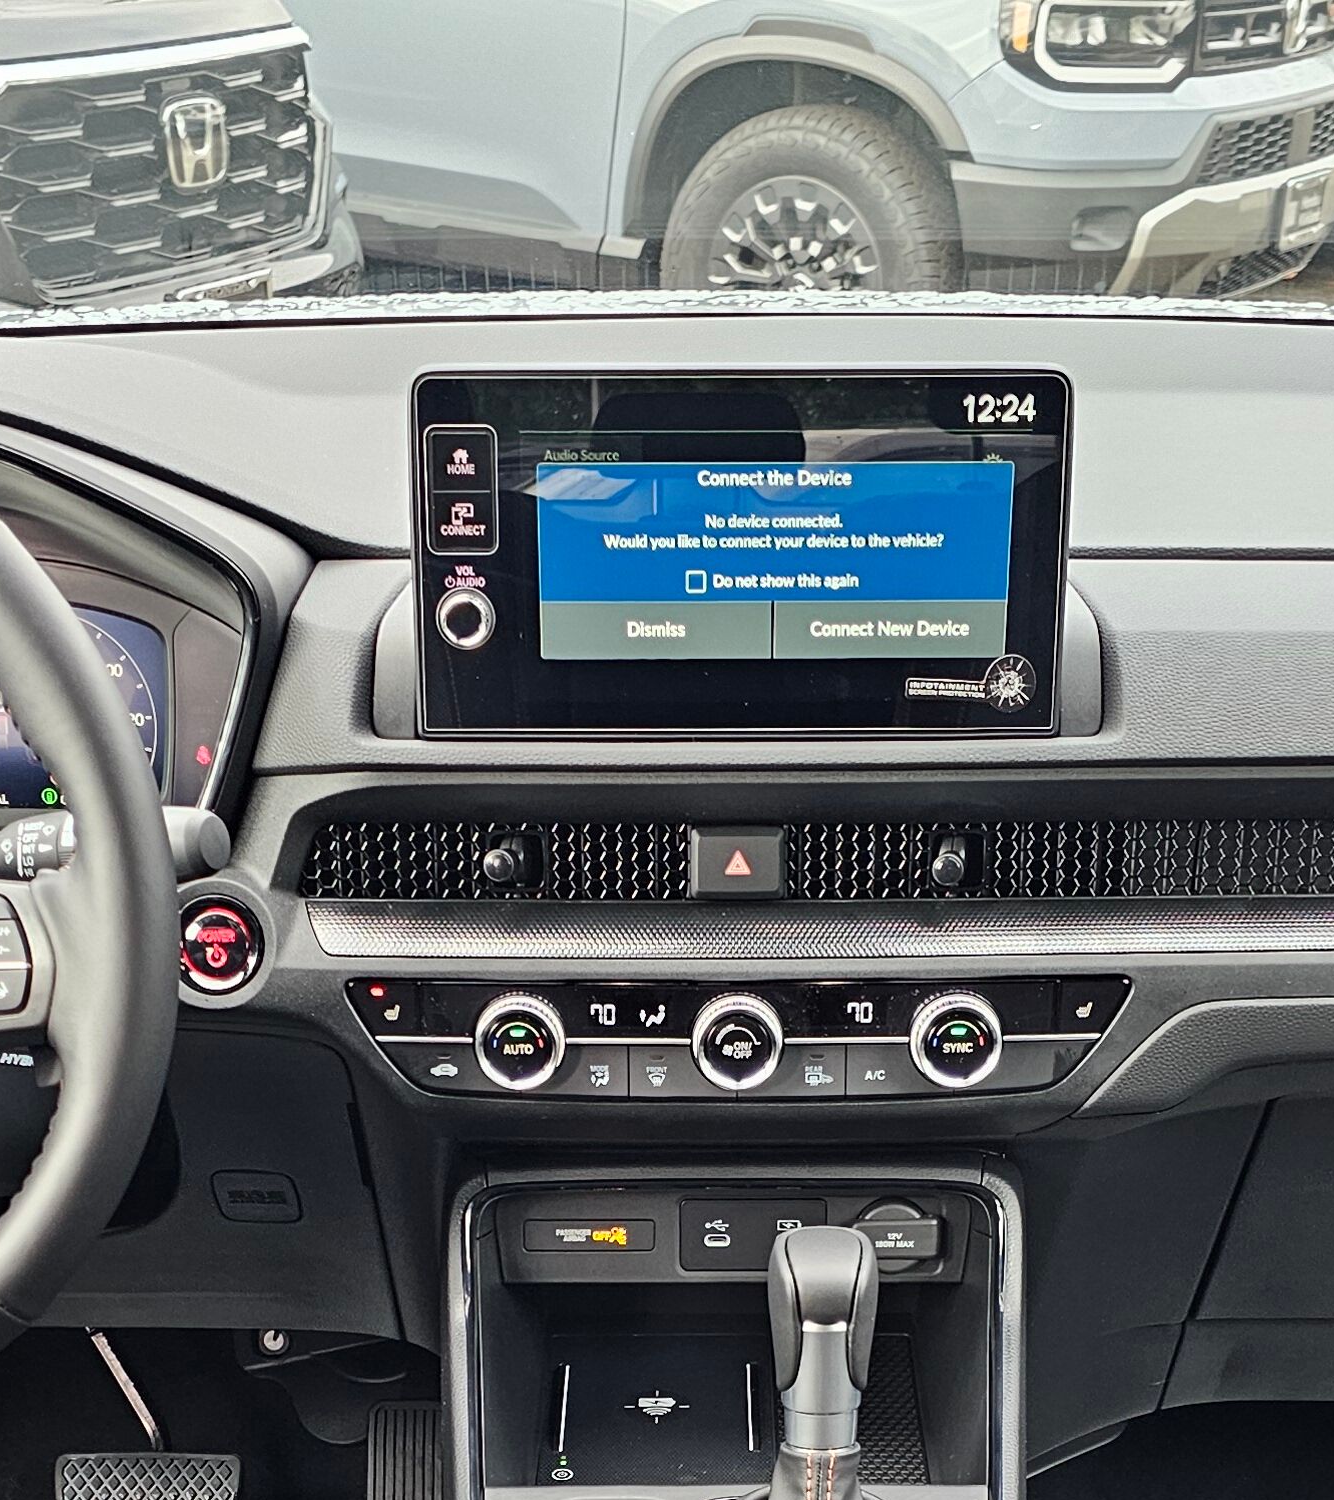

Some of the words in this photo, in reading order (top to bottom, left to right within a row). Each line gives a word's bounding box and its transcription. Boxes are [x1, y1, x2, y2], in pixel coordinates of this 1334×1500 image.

[963, 393, 1037, 423] 12:24
[544, 450, 578, 462] Audio
[580, 450, 620, 462] Source
[447, 464, 475, 475] HOME
[697, 470, 764, 486] Connect
[767, 469, 794, 486] the
[797, 470, 852, 486] Device
[705, 514, 725, 528] No
[727, 513, 770, 528] device
[771, 513, 843, 529] connected.
[440, 525, 486, 536] CONNECT
[604, 534, 648, 549] Would
[650, 537, 676, 551] you
[677, 534, 701, 548] like
[702, 536, 717, 549] to
[719, 535, 772, 549] connect
[774, 537, 804, 550] your
[806, 533, 849, 548] device
[851, 535, 866, 548] to
[868, 533, 891, 548] the
[893, 533, 944, 548] vehicle?
[455, 566, 475, 577] VOL
[456, 577, 486, 588] AUDIO
[713, 574, 733, 588] Do
[735, 574, 759, 588] not
[760, 574, 796, 588] show
[797, 573, 822, 588] this
[824, 575, 859, 591] again
[627, 621, 686, 638] Dismiss
[810, 621, 874, 637] Connect
[877, 621, 915, 637] New
[916, 620, 970, 637] Device
[22, 856, 35, 867] LO
[197, 928, 236, 943] POWER
[590, 1003, 616, 1026] 70
[847, 1001, 874, 1024] 70
[503, 1043, 535, 1056] AUTO
[733, 1049, 753, 1060] OFF
[942, 1042, 974, 1054] SYNC
[864, 1069, 886, 1081] A/C
